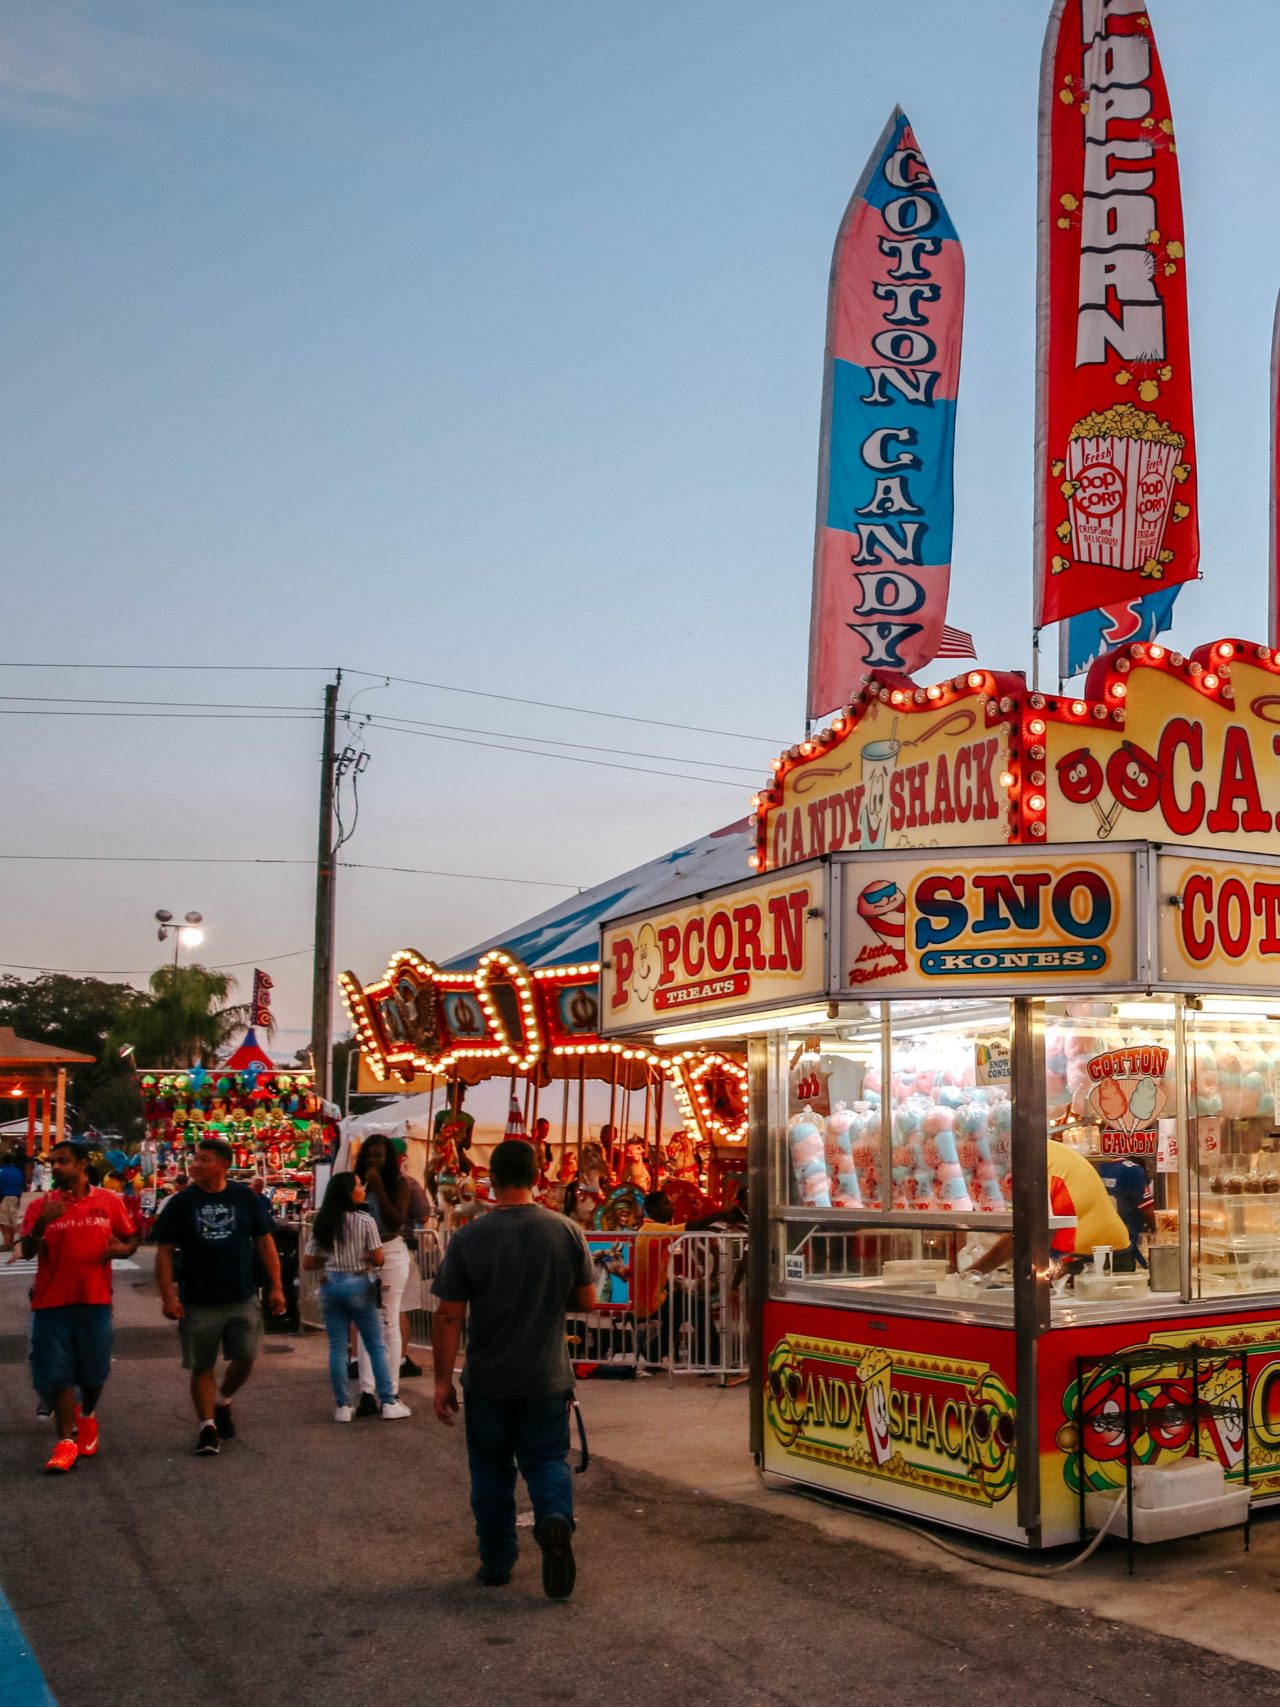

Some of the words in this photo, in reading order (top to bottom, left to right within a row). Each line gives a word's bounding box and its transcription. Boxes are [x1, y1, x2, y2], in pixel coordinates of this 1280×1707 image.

[863, 148, 940, 409] COTTON
[1084, 447, 1112, 465] Fresh
[846, 427, 926, 668] CANDY
[773, 784, 866, 868] CANDY
[889, 738, 999, 832] SHACK
[915, 869, 1112, 950] SNO
[940, 950, 1085, 970] KONES
[667, 980, 735, 1003] TREATS
[1087, 1046, 1168, 1081] COTTON
[1101, 1130, 1158, 1157] CANDY
[888, 1389, 979, 1465] SHACK
